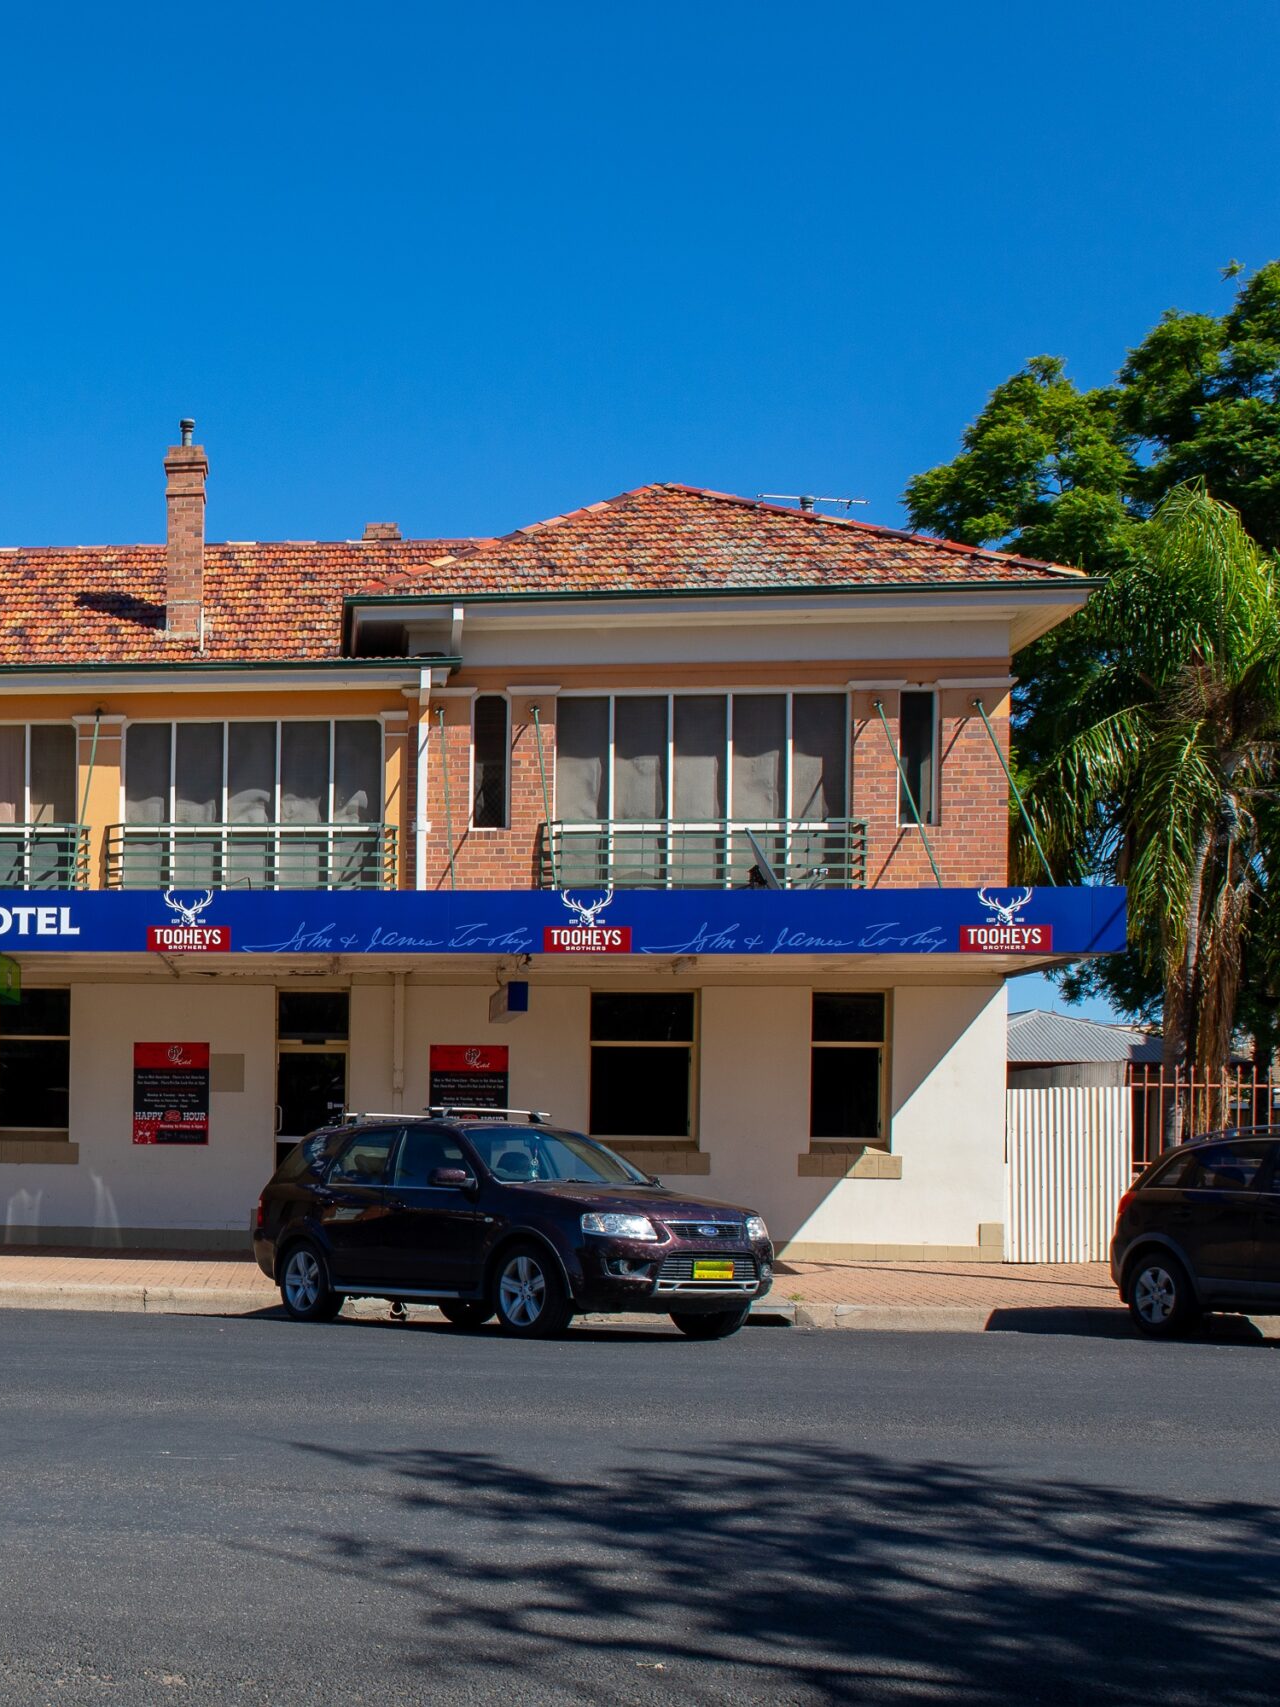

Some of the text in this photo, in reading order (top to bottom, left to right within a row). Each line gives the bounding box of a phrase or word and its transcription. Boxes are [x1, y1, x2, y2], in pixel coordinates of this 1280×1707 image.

[154, 929, 221, 944] TOOHEYS
[551, 930, 622, 945] TOOHEYS
[967, 928, 1042, 944] TOOHEYS
[134, 1111, 206, 1121] HAPPY HOUR
